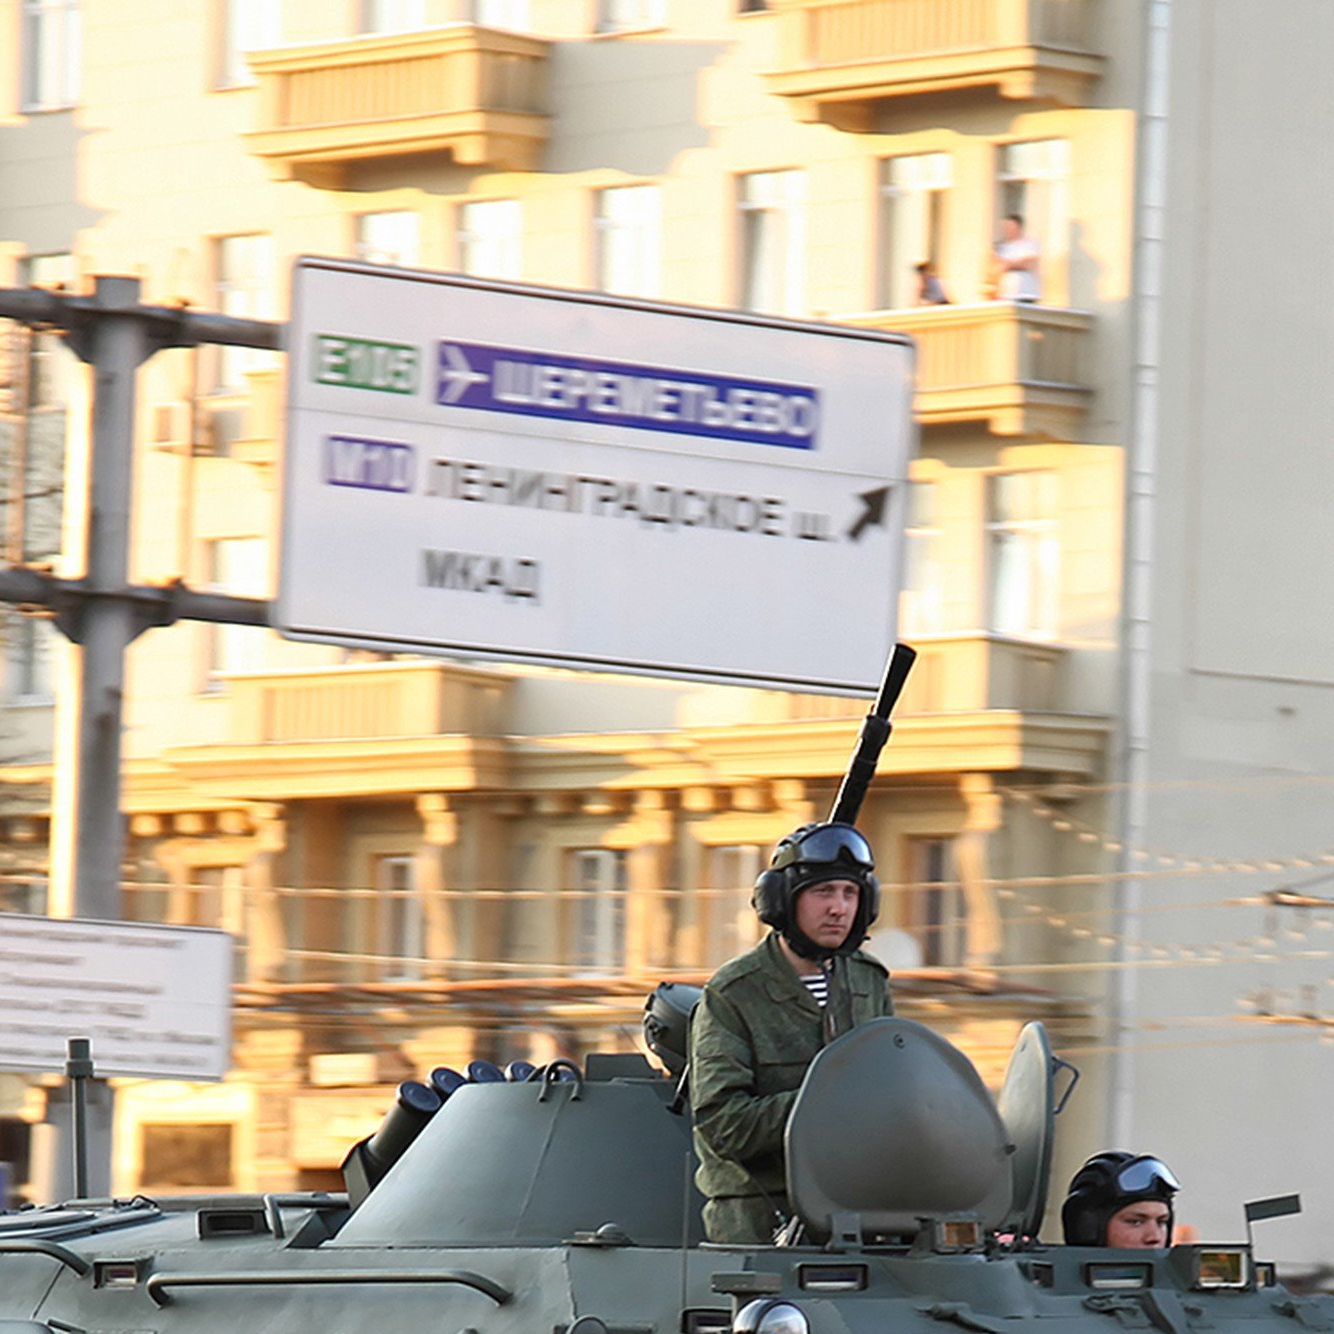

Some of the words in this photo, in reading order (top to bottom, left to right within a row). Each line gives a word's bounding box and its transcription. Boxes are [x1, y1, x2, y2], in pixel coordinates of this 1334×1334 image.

[320, 340, 417, 391] E105
[495, 360, 816, 436] ШЕРЕМЕТЬЕВО
[426, 460, 785, 535] ЛЕНИНГРАДСКОЕ
[792, 510, 835, 541] ш.
[423, 550, 540, 604] МКАД
